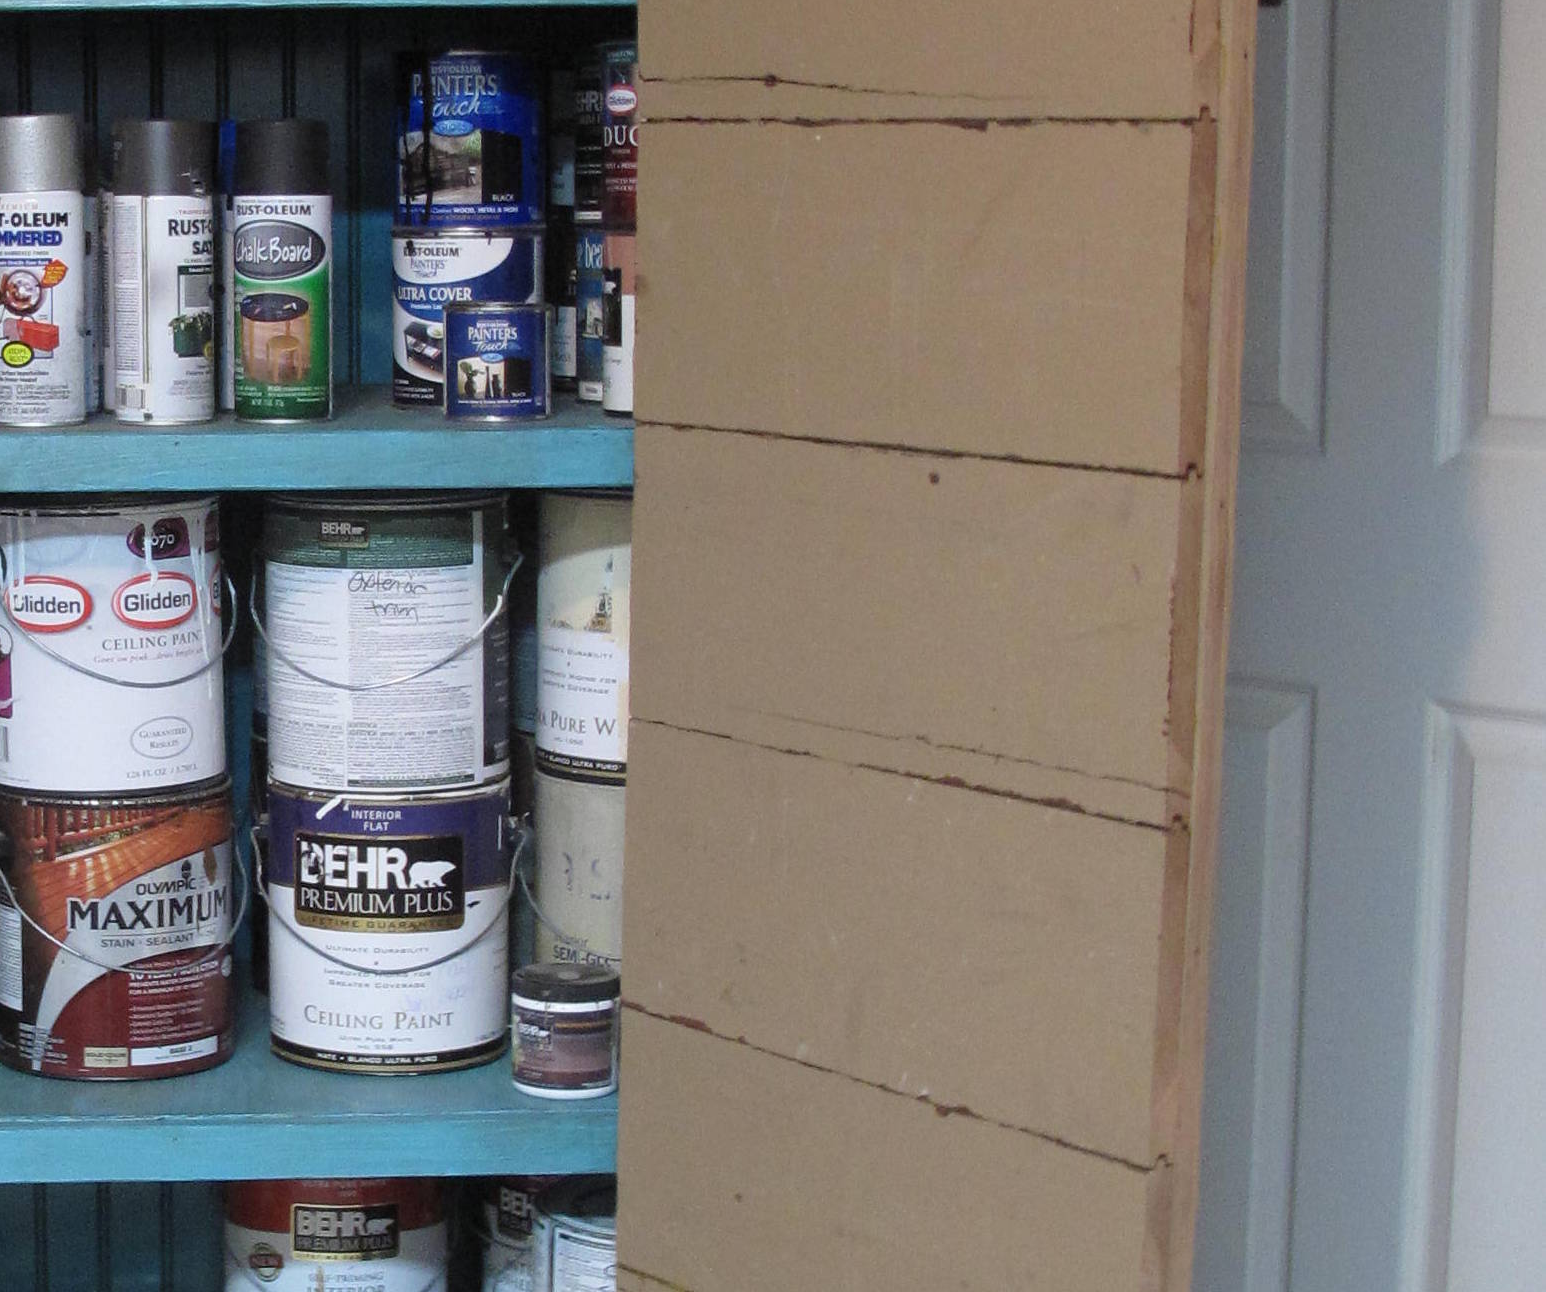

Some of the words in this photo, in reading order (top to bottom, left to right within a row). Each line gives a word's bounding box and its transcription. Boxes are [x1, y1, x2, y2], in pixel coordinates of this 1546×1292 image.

[492, 193, 514, 202] BLACK
[397, 287, 427, 301] ULTRA
[429, 287, 472, 301] COVER
[320, 521, 352, 535] BEHR
[124, 591, 191, 612] Glidden
[102, 635, 167, 651] CEILING
[550, 709, 587, 734] PURE
[351, 809, 402, 820] INTERIOR
[363, 821, 389, 832] FLAT
[300, 840, 408, 890] BEHR
[136, 877, 197, 896] OLYMPIC
[69, 886, 227, 930] MAXIMUM
[301, 886, 395, 914] PREMIUM
[405, 891, 453, 914] PLUS
[101, 938, 135, 948] STAIN
[146, 932, 194, 947] SEALANT
[328, 979, 370, 989] GREATER
[304, 1004, 383, 1030] CEILING
[393, 1011, 454, 1029] PAINT
[500, 1187, 533, 1218] BEH
[297, 1210, 367, 1237] BEHR
[309, 1271, 384, 1283] SF-PRIMING
